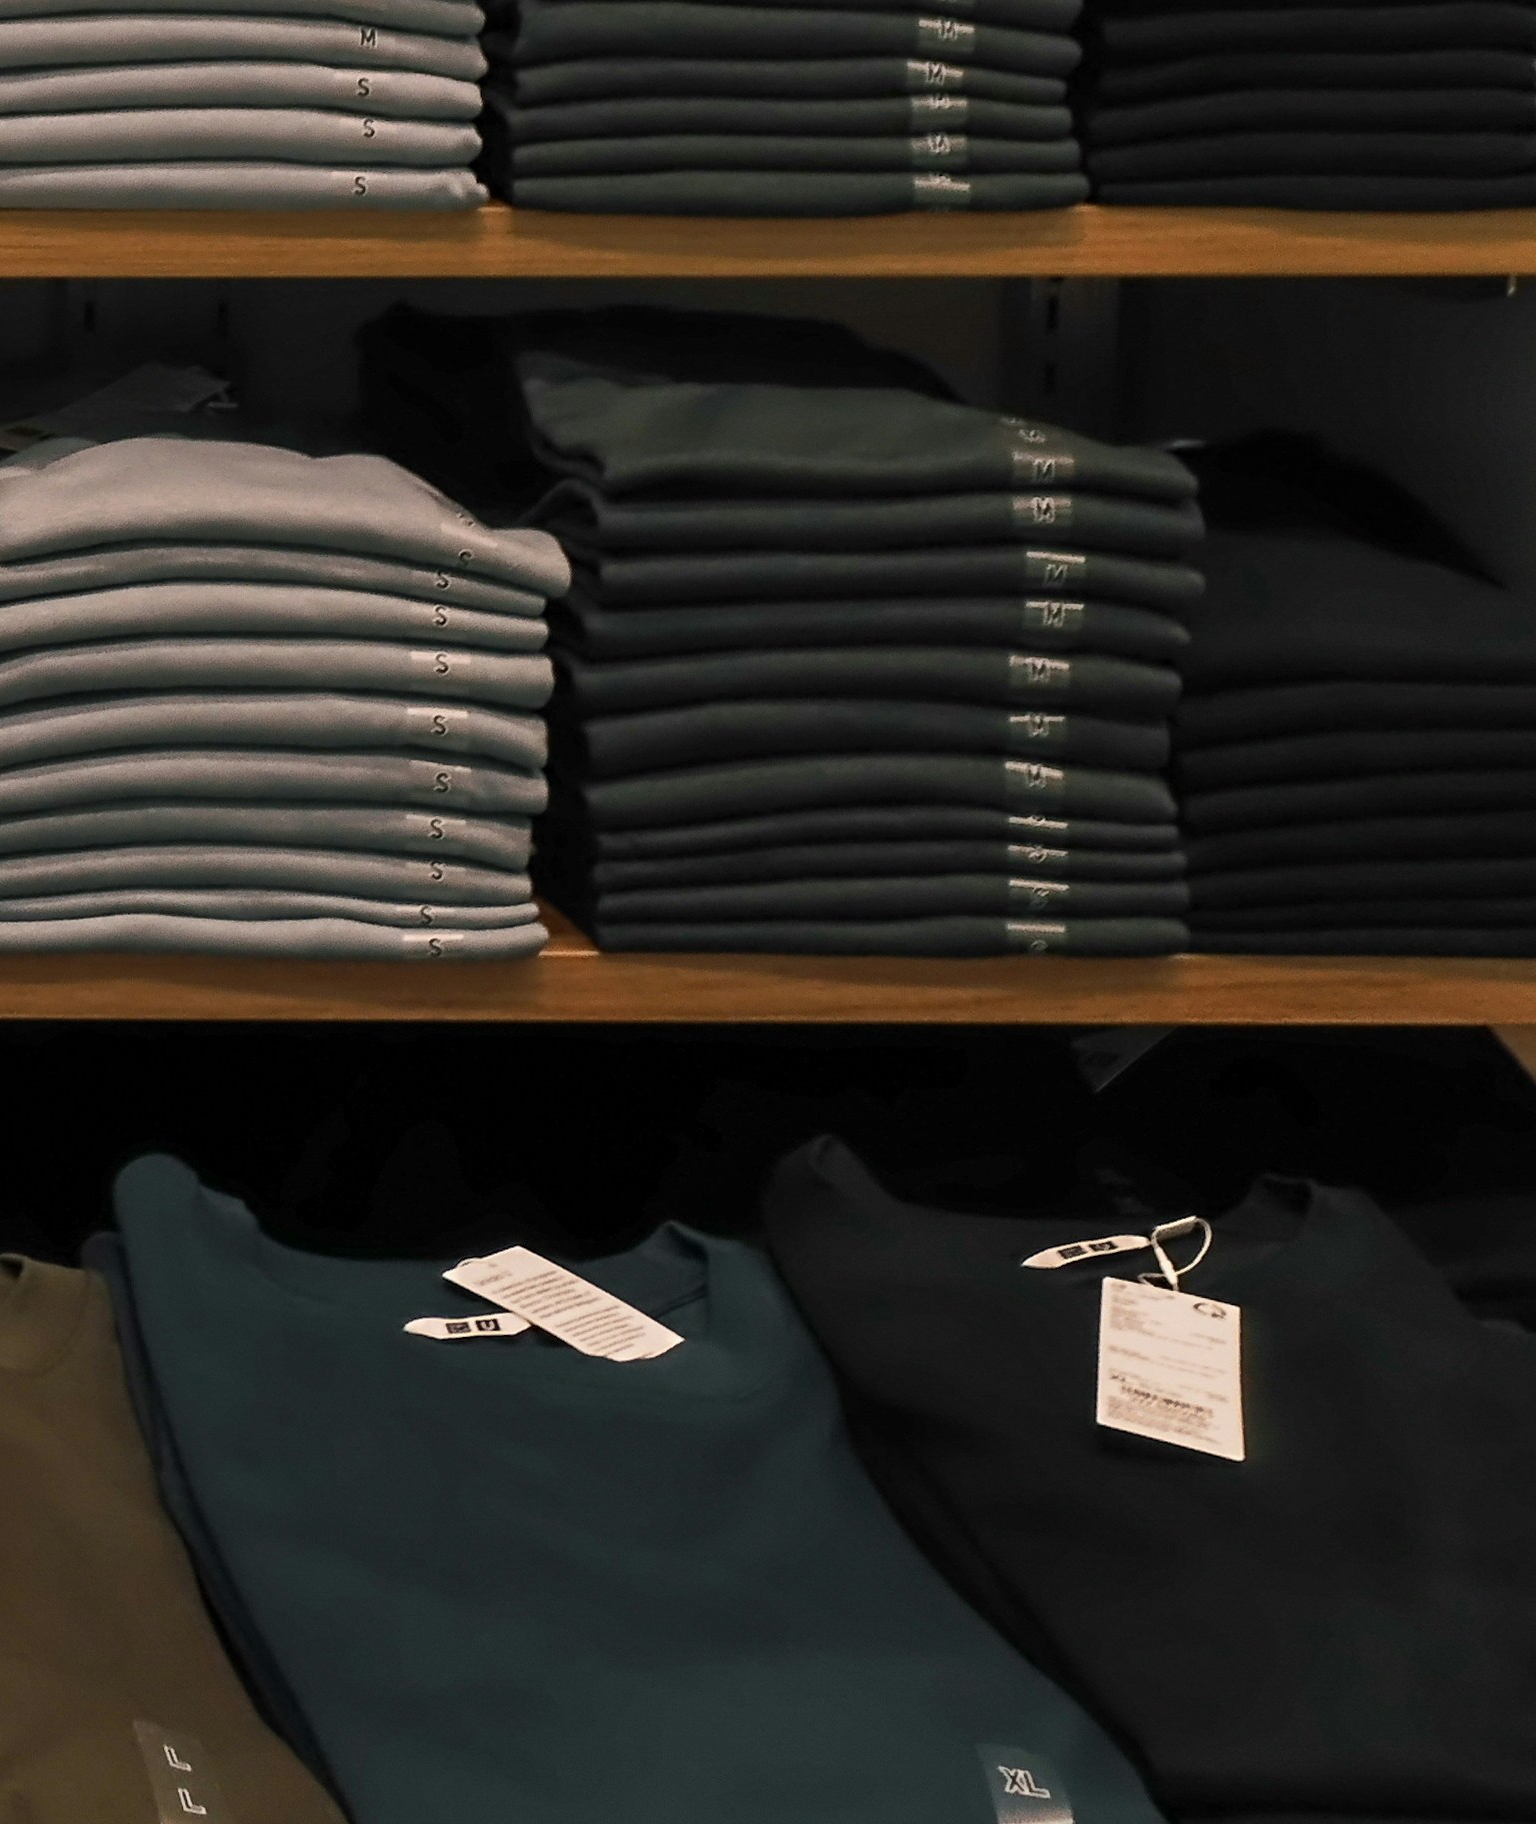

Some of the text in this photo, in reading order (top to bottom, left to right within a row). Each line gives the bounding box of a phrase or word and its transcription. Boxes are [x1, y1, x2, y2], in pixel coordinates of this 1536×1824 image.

[358, 78, 369, 97] S
[364, 119, 375, 138] S
[355, 177, 366, 196] S
[435, 654, 448, 673] S
[433, 715, 446, 735] S
[436, 773, 449, 793] S
[430, 819, 443, 839] S
[429, 938, 441, 957] S
[164, 1744, 192, 1772] L
[997, 1765, 1051, 1799] XL
[178, 1788, 207, 1815] L
